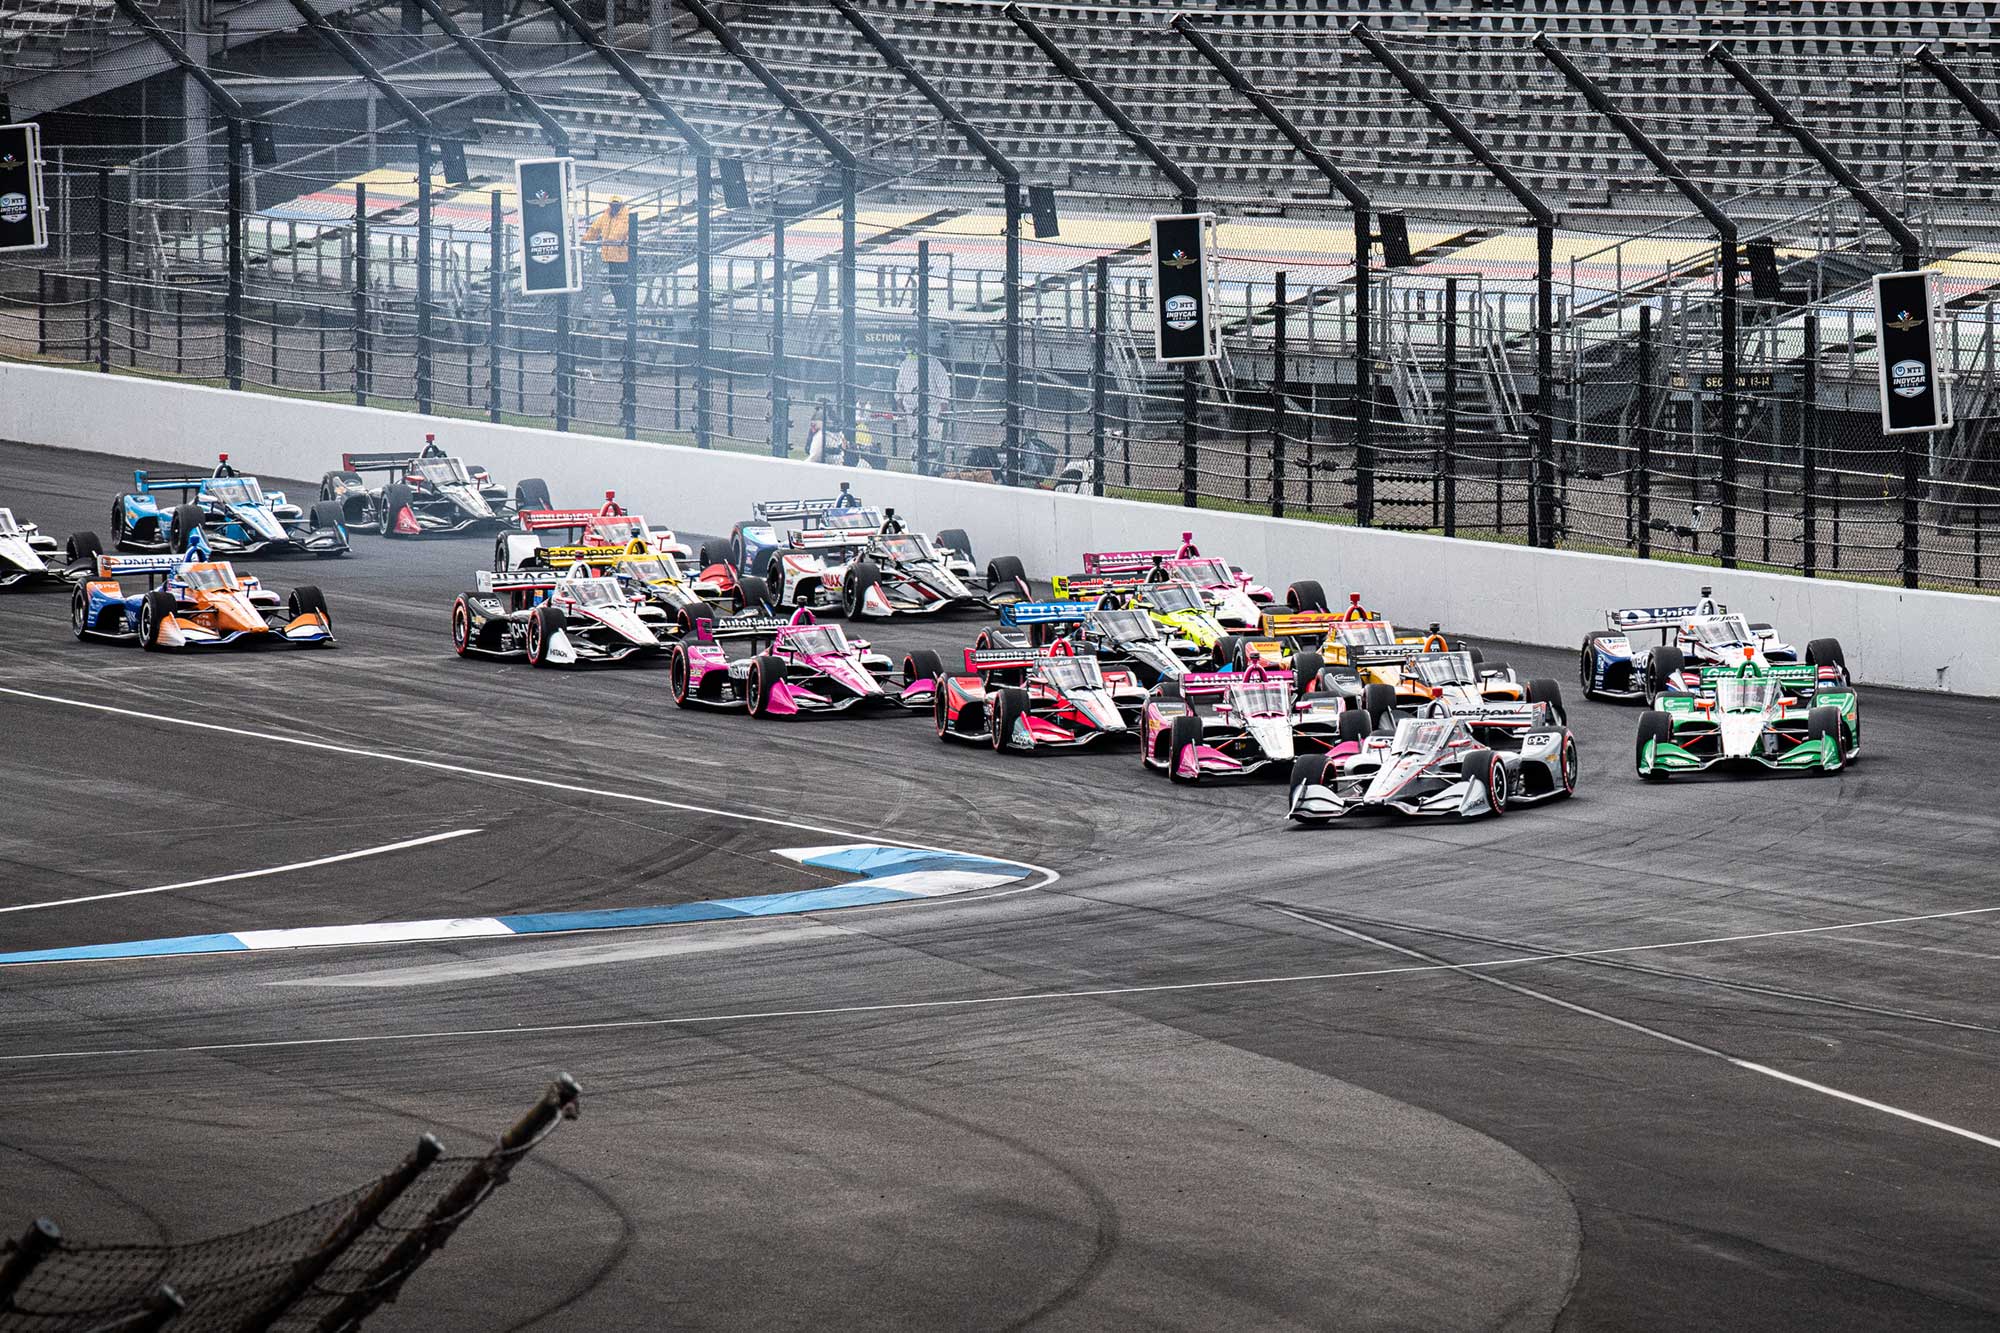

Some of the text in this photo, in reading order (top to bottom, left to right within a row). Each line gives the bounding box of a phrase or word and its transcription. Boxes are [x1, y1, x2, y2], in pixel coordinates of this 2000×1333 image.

[1166, 310, 1197, 318] INDYCAR
[865, 333, 901, 342] SECTION
[1893, 376, 1926, 385] INDYCAR
[718, 616, 789, 628] AutoNation
[1759, 665, 1813, 678] Energy
